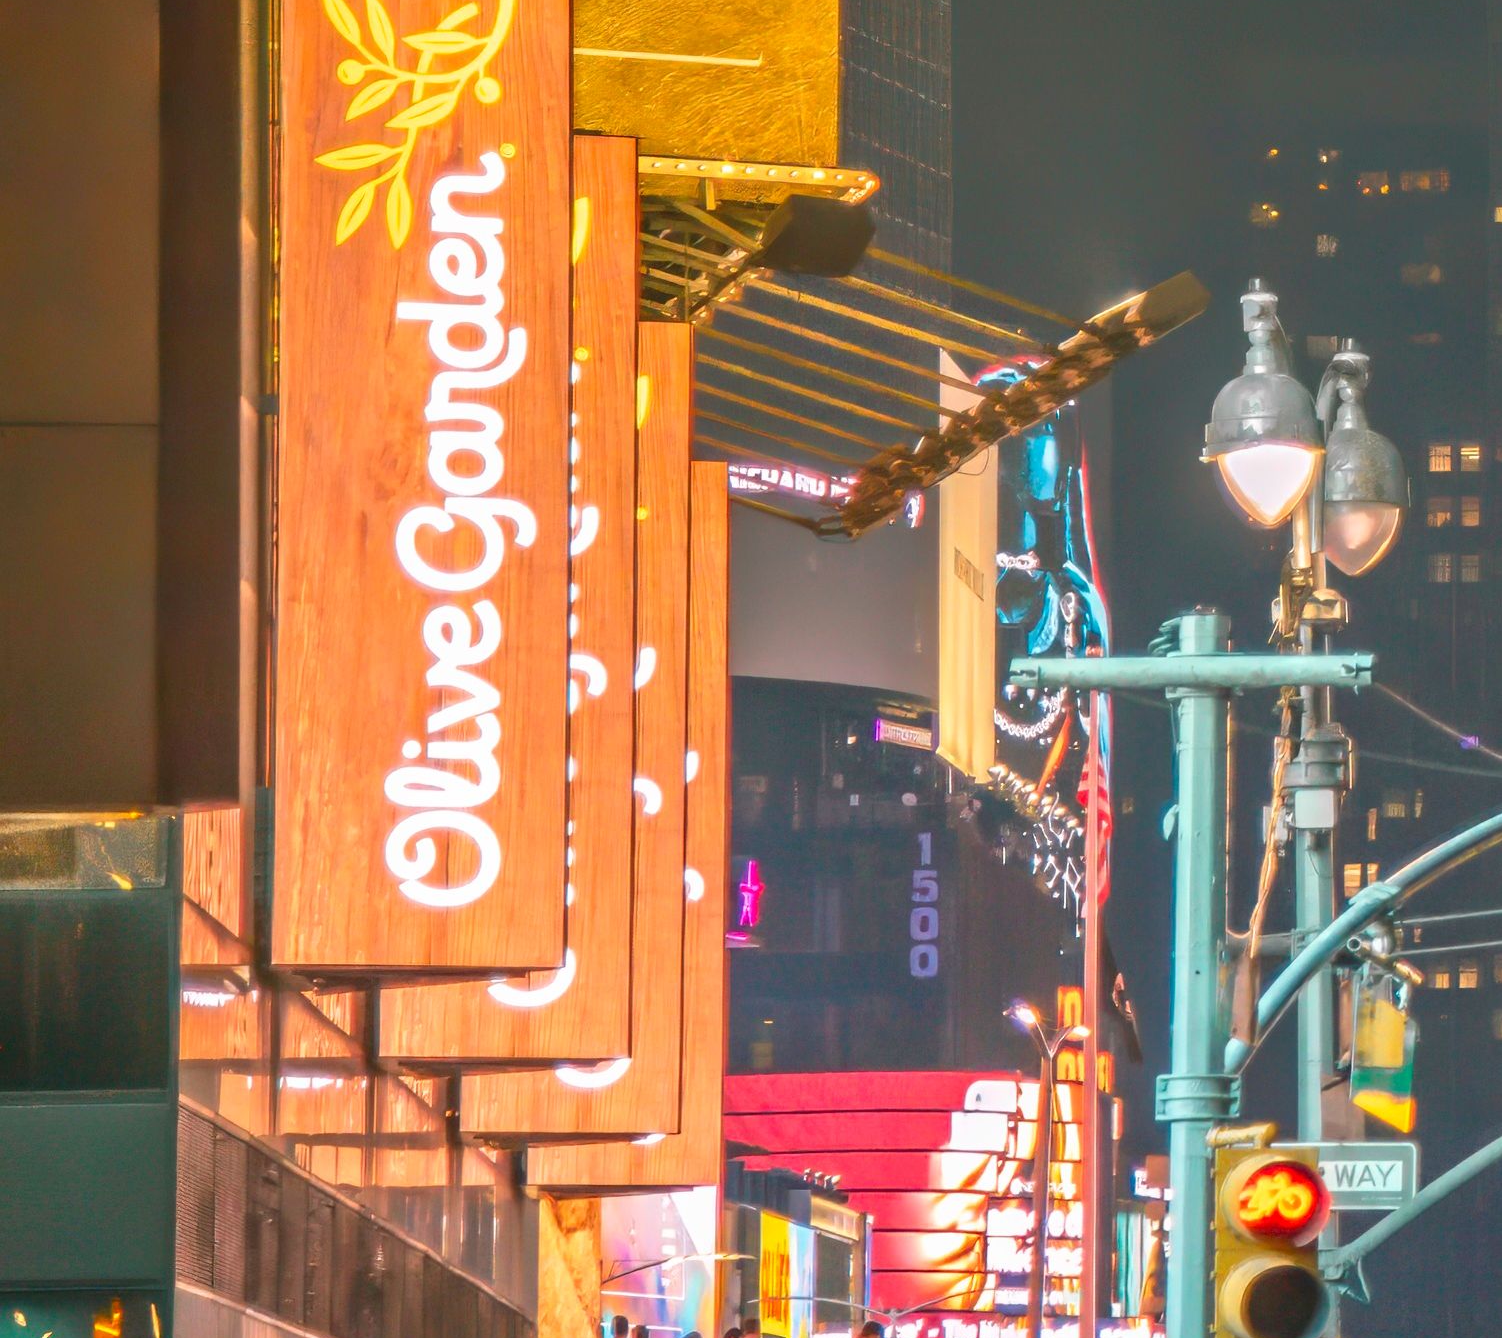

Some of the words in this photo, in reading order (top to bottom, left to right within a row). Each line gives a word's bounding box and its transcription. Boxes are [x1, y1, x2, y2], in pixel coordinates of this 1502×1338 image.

[395, 147, 537, 591] Garden
[385, 599, 500, 907] Olive
[909, 831, 940, 978] 1500
[1335, 1164, 1396, 1192] WAY
